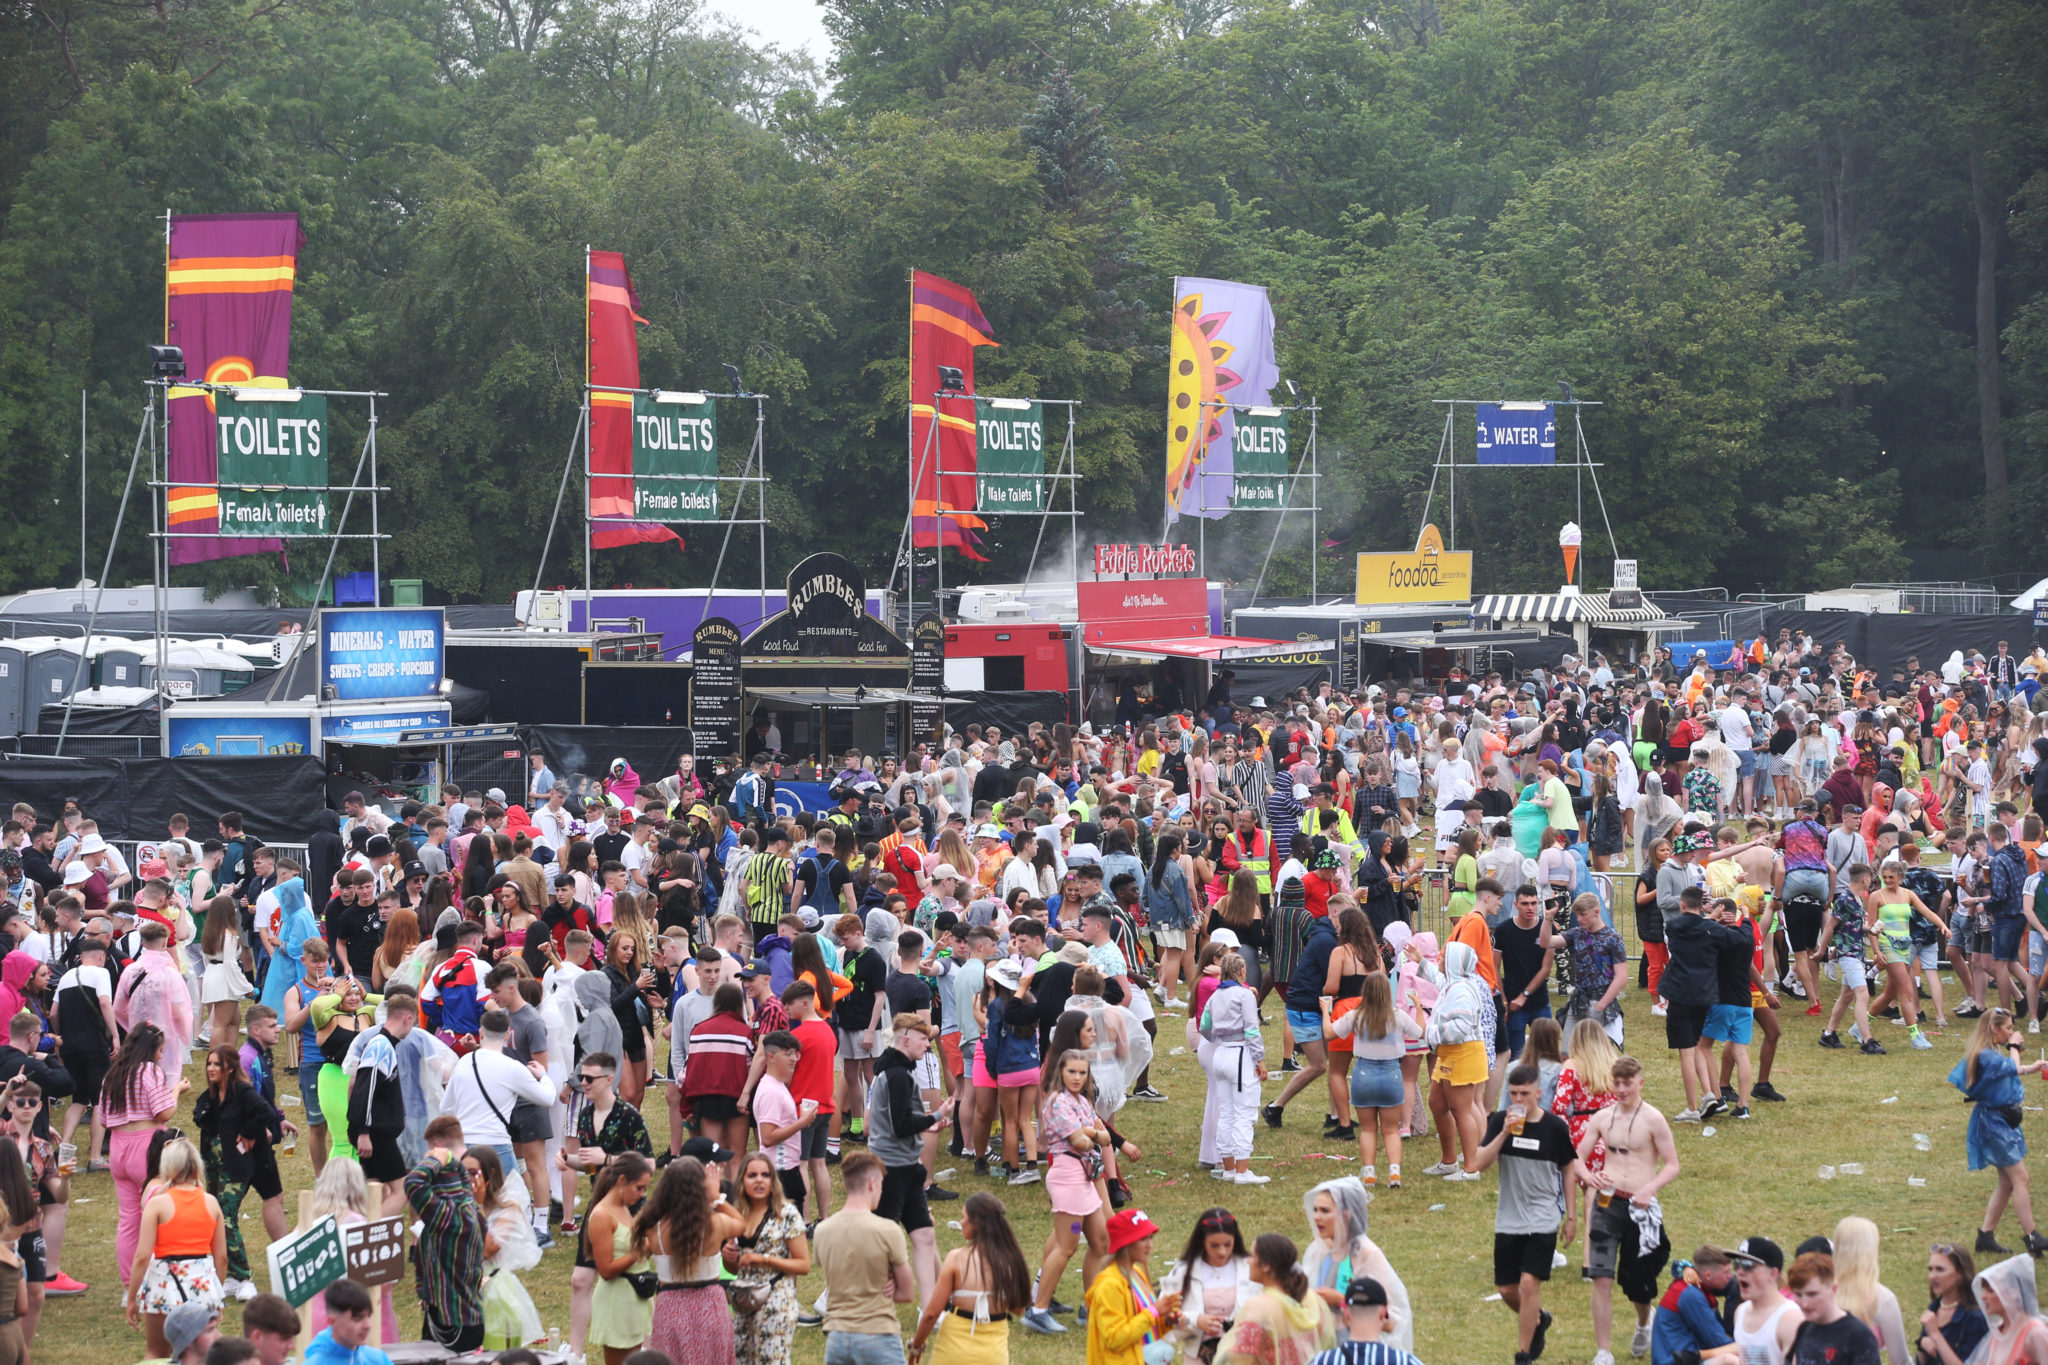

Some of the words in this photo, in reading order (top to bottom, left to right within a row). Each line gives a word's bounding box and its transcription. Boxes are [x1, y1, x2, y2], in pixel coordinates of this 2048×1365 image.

[218, 416, 320, 457] TOILETS
[636, 415, 714, 452] TOILETS
[979, 420, 1042, 451] TOILETS
[1235, 425, 1287, 455] TOILETS
[1493, 427, 1538, 445] WATER
[642, 490, 678, 509] Female
[680, 491, 711, 510] Toilets
[1007, 487, 1033, 502] Toilets
[1240, 486, 1257, 500] Male
[275, 503, 316, 523] Toilets
[1095, 543, 1139, 574] Eddie
[1388, 560, 1439, 588] foodoo
[1615, 563, 1636, 577] WATER
[791, 574, 863, 619] RUMBLES
[330, 631, 384, 652] MINERALS
[398, 630, 435, 650] WATER
[695, 624, 739, 643] RUMBLES
[806, 626, 853, 637] RESTAURANTS
[709, 648, 725, 656] MENU
[763, 640, 781, 651] Good
[858, 640, 875, 652] Good
[330, 663, 362, 679] SWEETS
[367, 662, 395, 677] CRISPS
[401, 661, 435, 676] POPCORN
